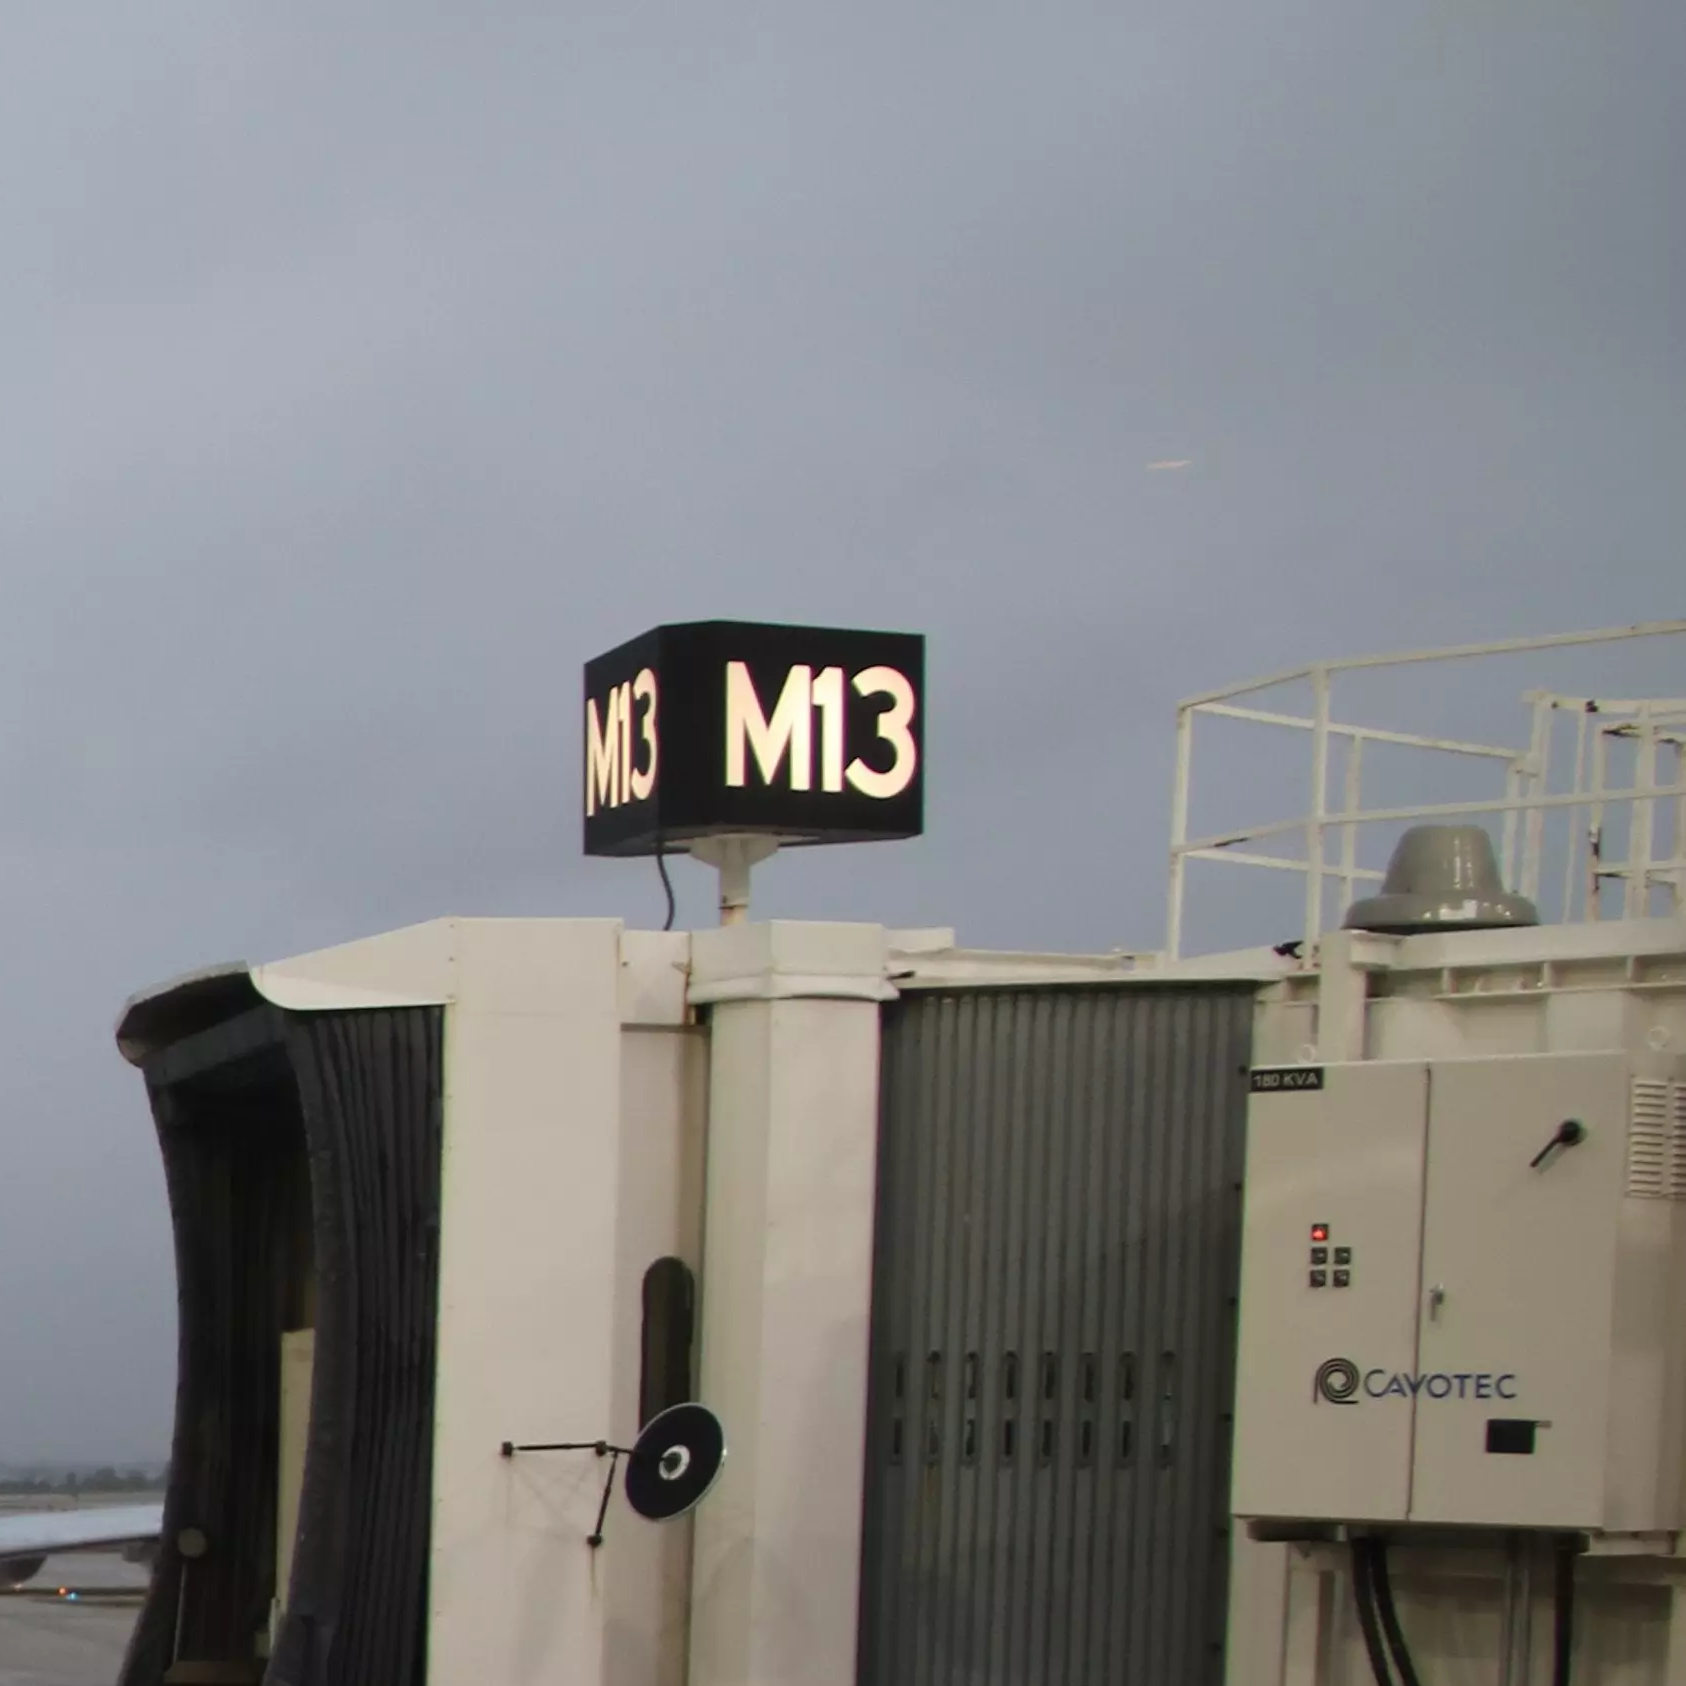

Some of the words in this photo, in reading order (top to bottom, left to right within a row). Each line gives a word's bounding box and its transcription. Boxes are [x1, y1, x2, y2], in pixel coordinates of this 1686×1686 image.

[586, 667, 658, 817] M13
[725, 660, 917, 799] M13
[1253, 1073, 1280, 1088] 180
[1283, 1071, 1319, 1087] KVA
